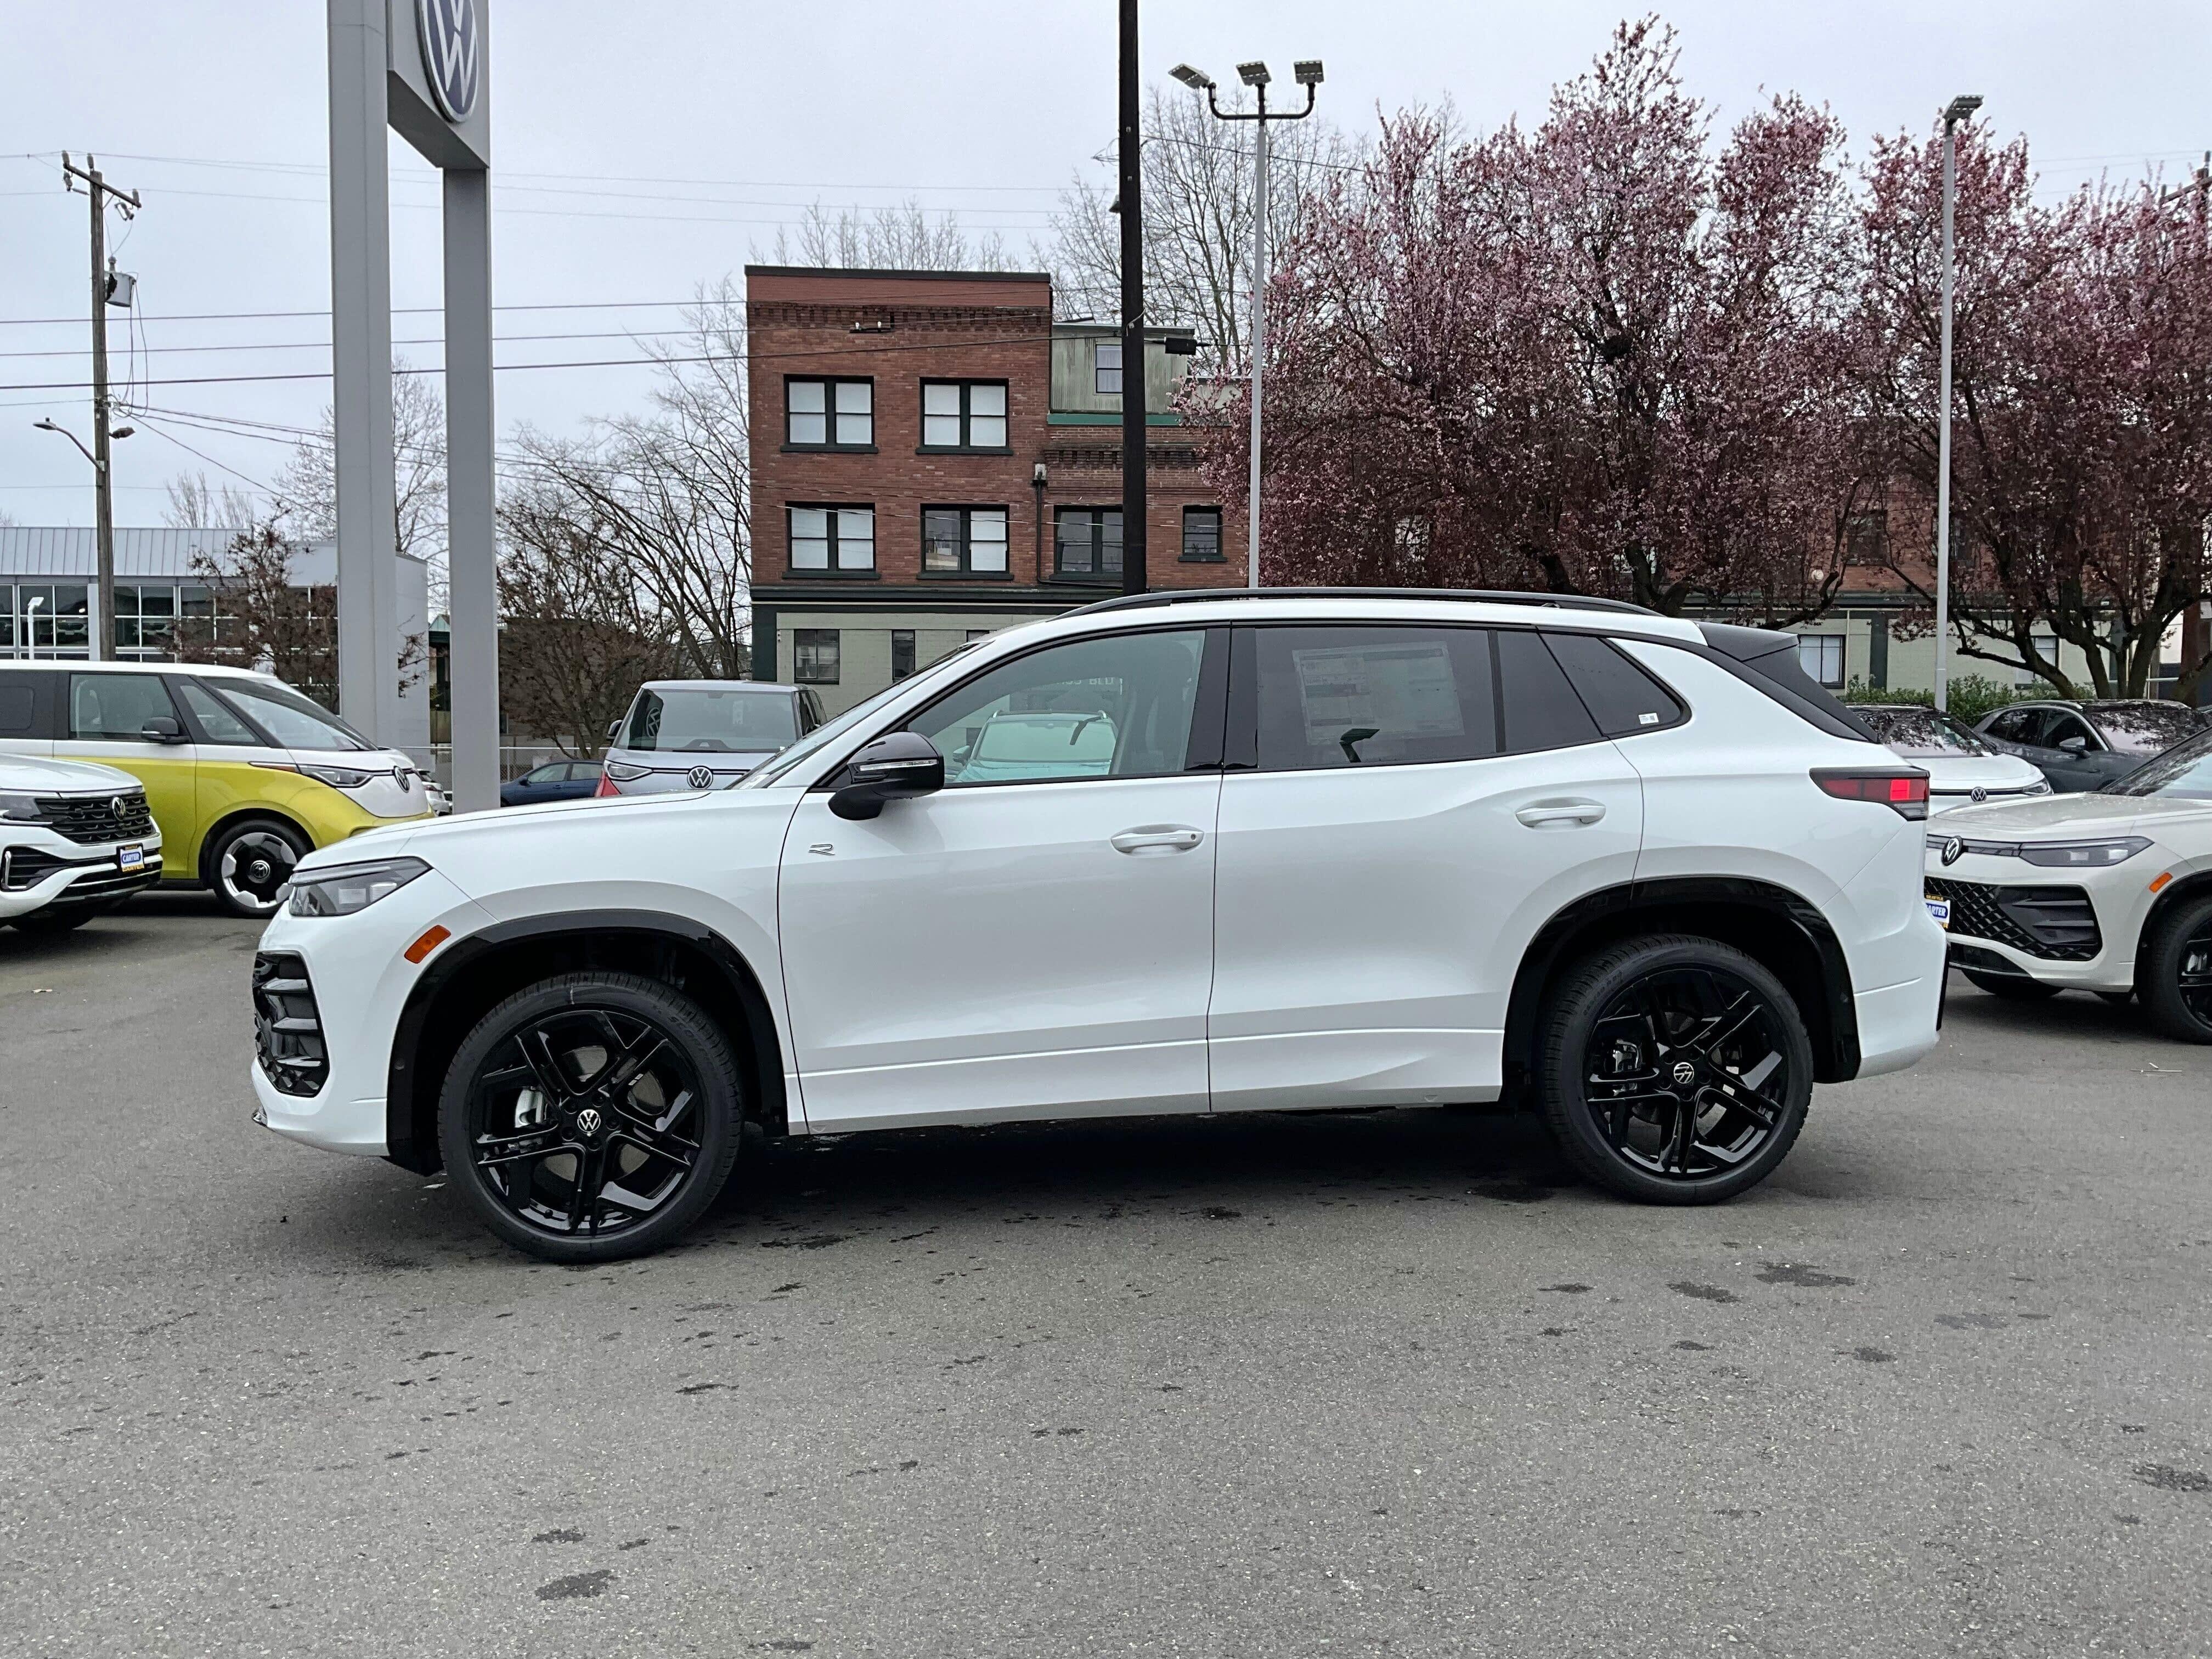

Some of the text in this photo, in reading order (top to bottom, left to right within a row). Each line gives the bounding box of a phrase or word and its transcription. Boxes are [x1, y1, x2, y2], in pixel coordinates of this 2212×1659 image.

[687, 766, 713, 789] VW
[1971, 787, 1987, 802] VW
[122, 853, 140, 862] CARTER
[1944, 838, 1959, 864] VW
[1928, 904, 1946, 917] ARTER
[577, 1109, 601, 1133] VW
